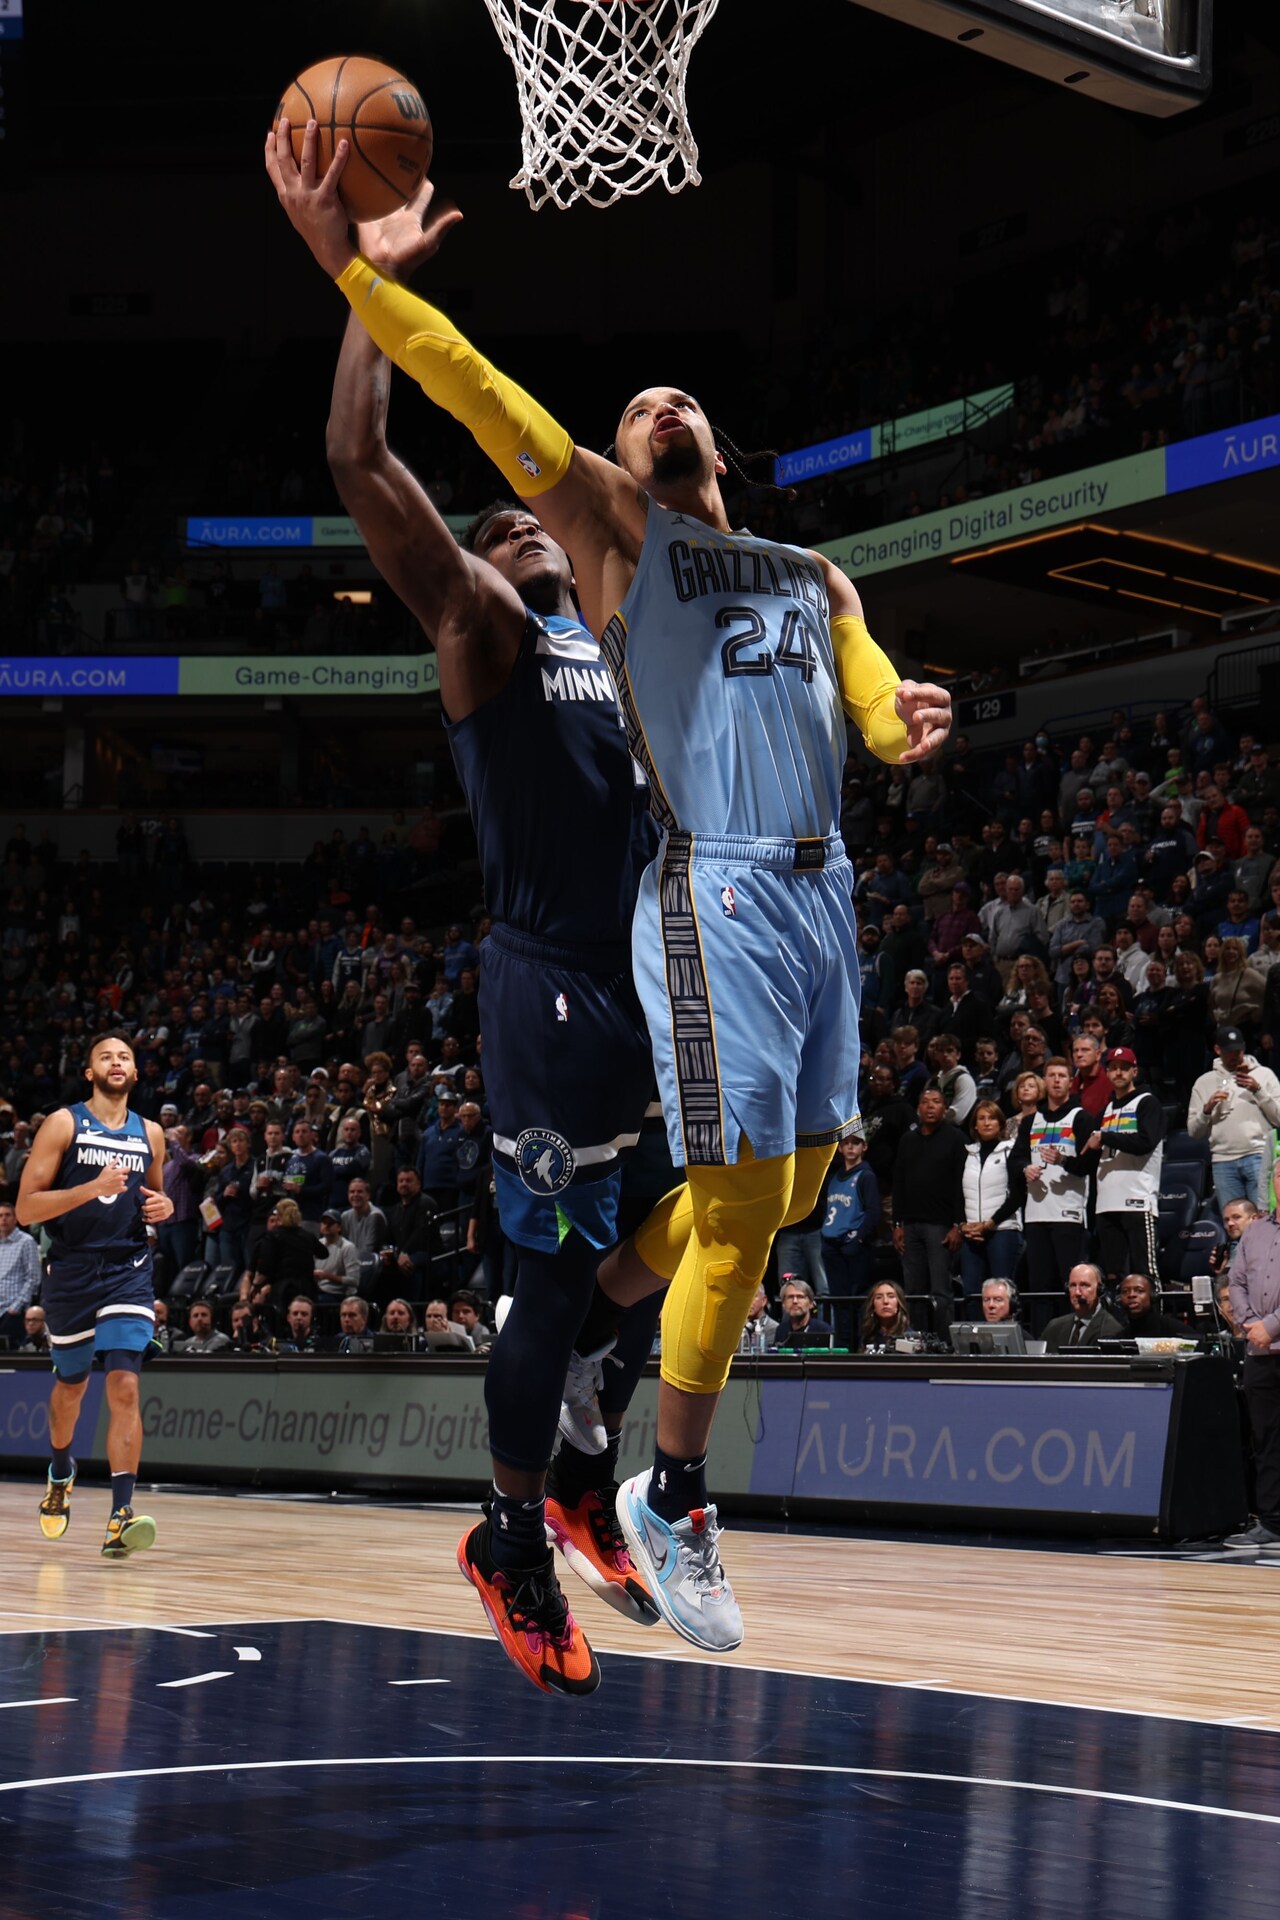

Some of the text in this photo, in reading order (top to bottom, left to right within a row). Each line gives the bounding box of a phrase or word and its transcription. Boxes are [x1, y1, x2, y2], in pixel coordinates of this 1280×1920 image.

[950, 504, 1012, 542] Digital
[1019, 479, 1109, 521] Security
[715, 606, 817, 683] 24
[235, 666, 418, 688] Game-Changing
[974, 699, 1001, 720] 129
[142, 1396, 390, 1456] Game-Changing
